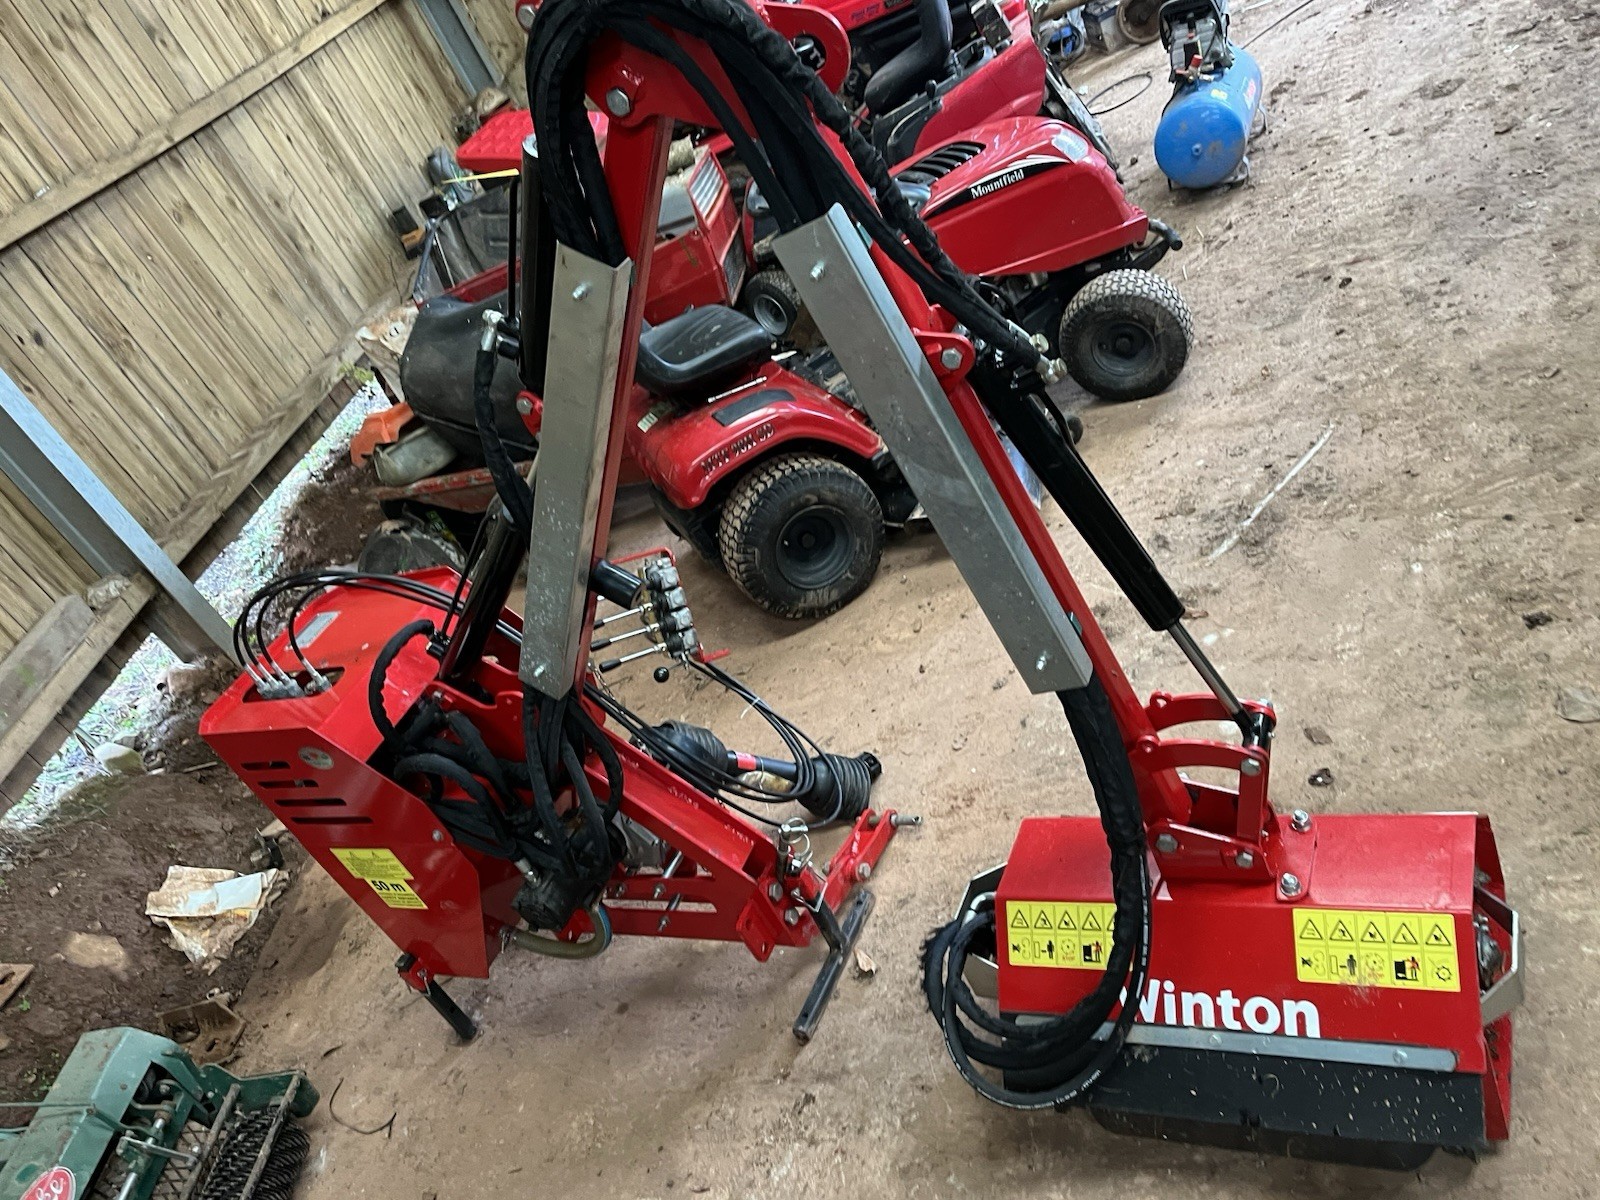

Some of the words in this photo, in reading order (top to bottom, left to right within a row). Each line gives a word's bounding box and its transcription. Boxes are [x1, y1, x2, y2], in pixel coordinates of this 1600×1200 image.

[970, 169, 1025, 199] Mountfield
[371, 880, 390, 892] 50
[390, 882, 406, 893] m
